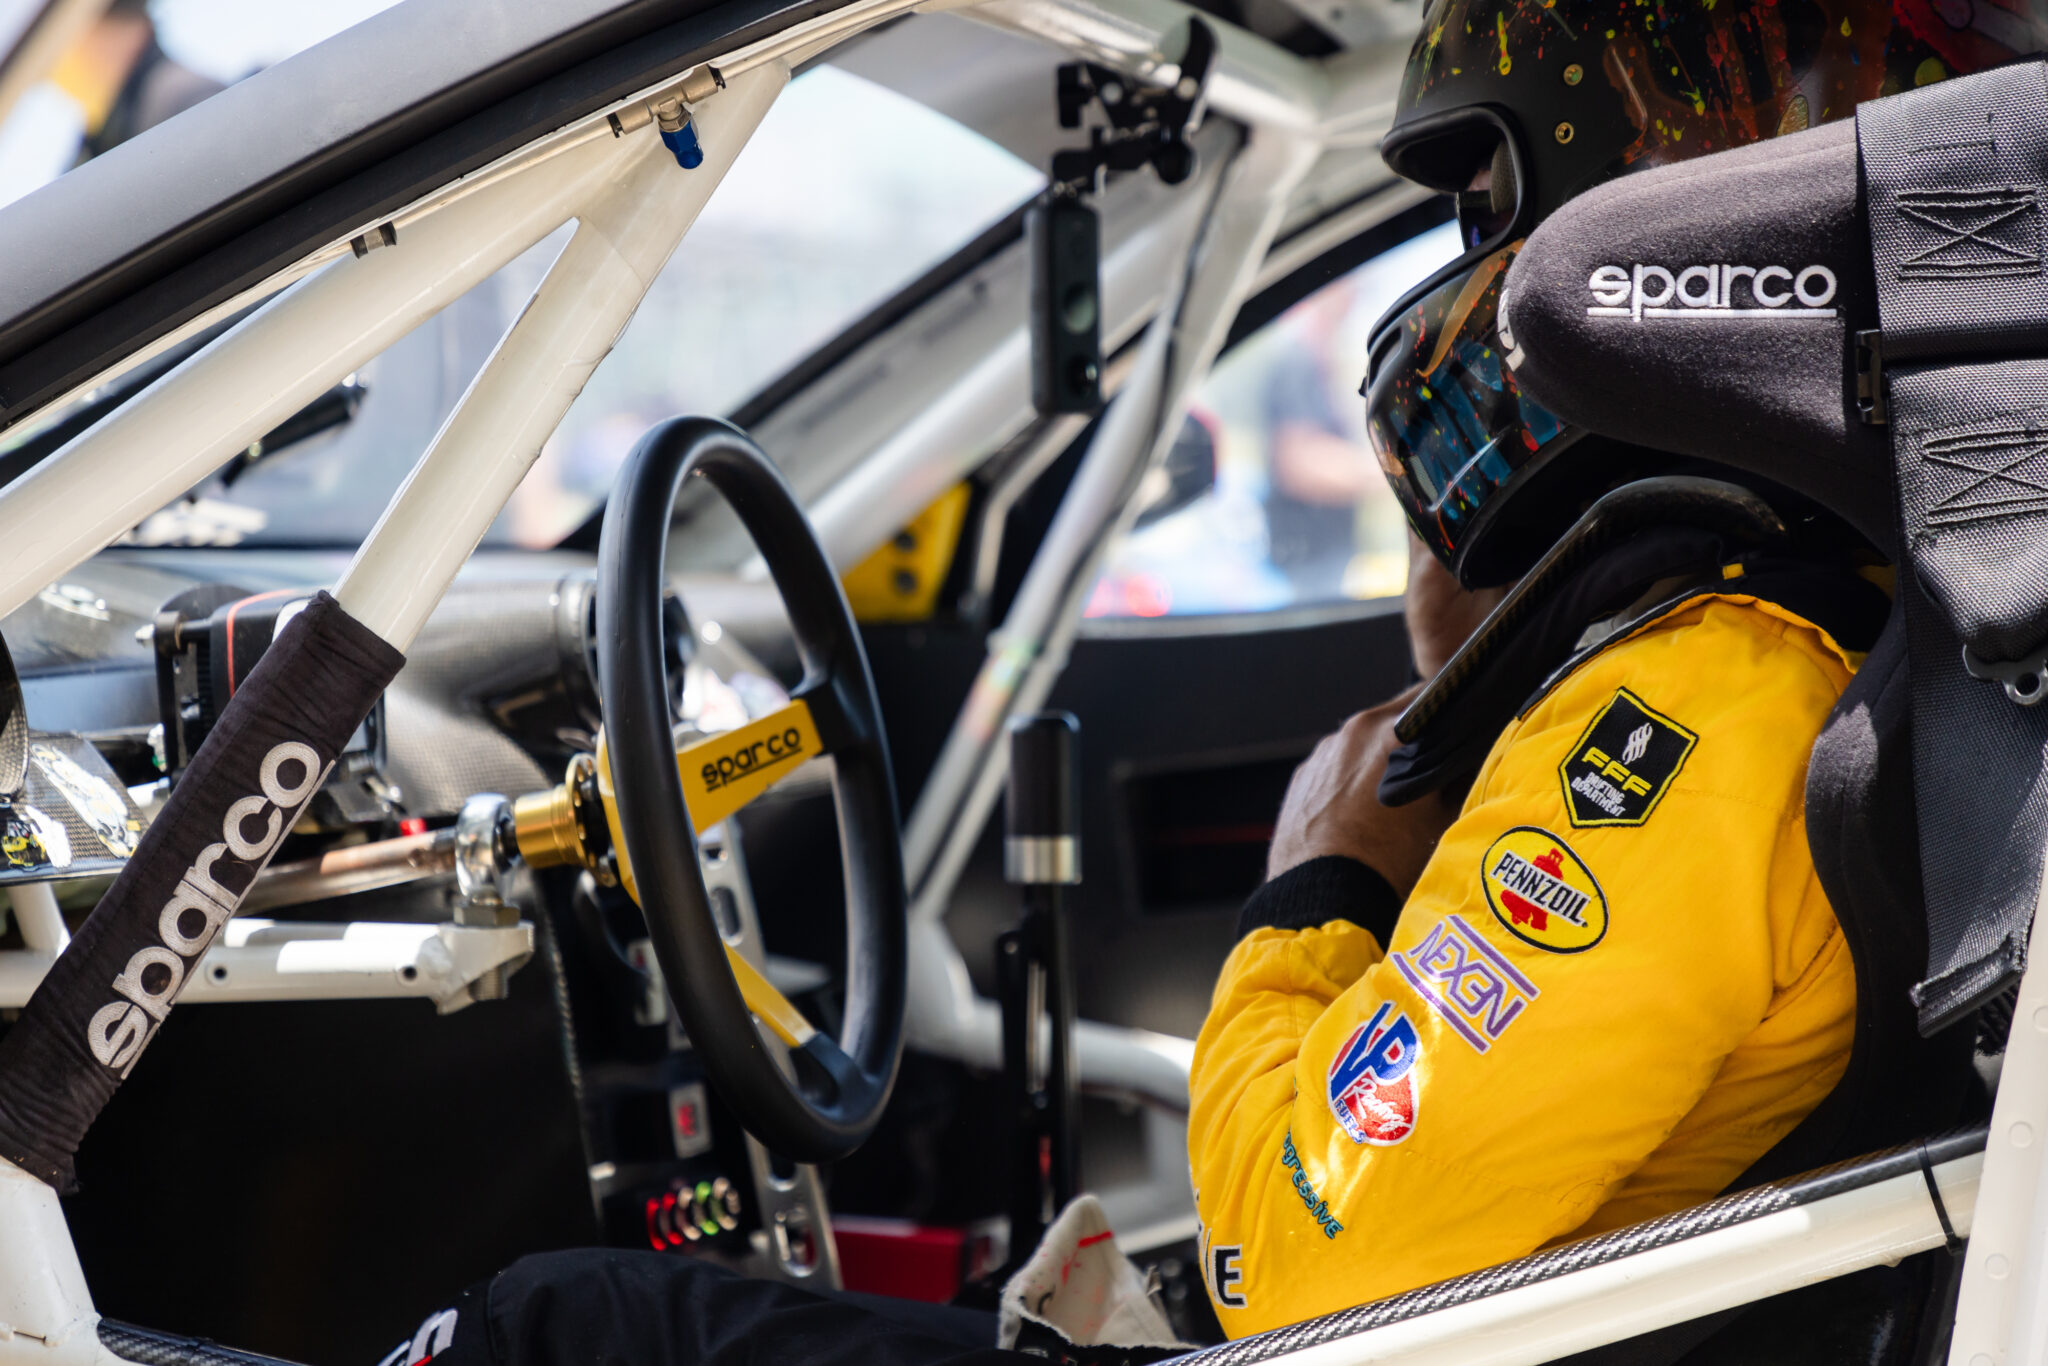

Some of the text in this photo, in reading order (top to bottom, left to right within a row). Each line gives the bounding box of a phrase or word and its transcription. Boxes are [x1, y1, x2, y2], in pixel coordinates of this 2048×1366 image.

[1587, 264, 1838, 321] sparco
[701, 727, 802, 790] sparco
[1582, 746, 1652, 797] FFF
[1585, 771, 1625, 805] DRIFTING
[1571, 776, 1626, 817] DEPARTMENT
[88, 741, 326, 1070] sparco
[1491, 852, 1590, 927] PENNZOIL
[1406, 921, 1528, 1041] NEXEN
[1330, 1001, 1418, 1101] VP
